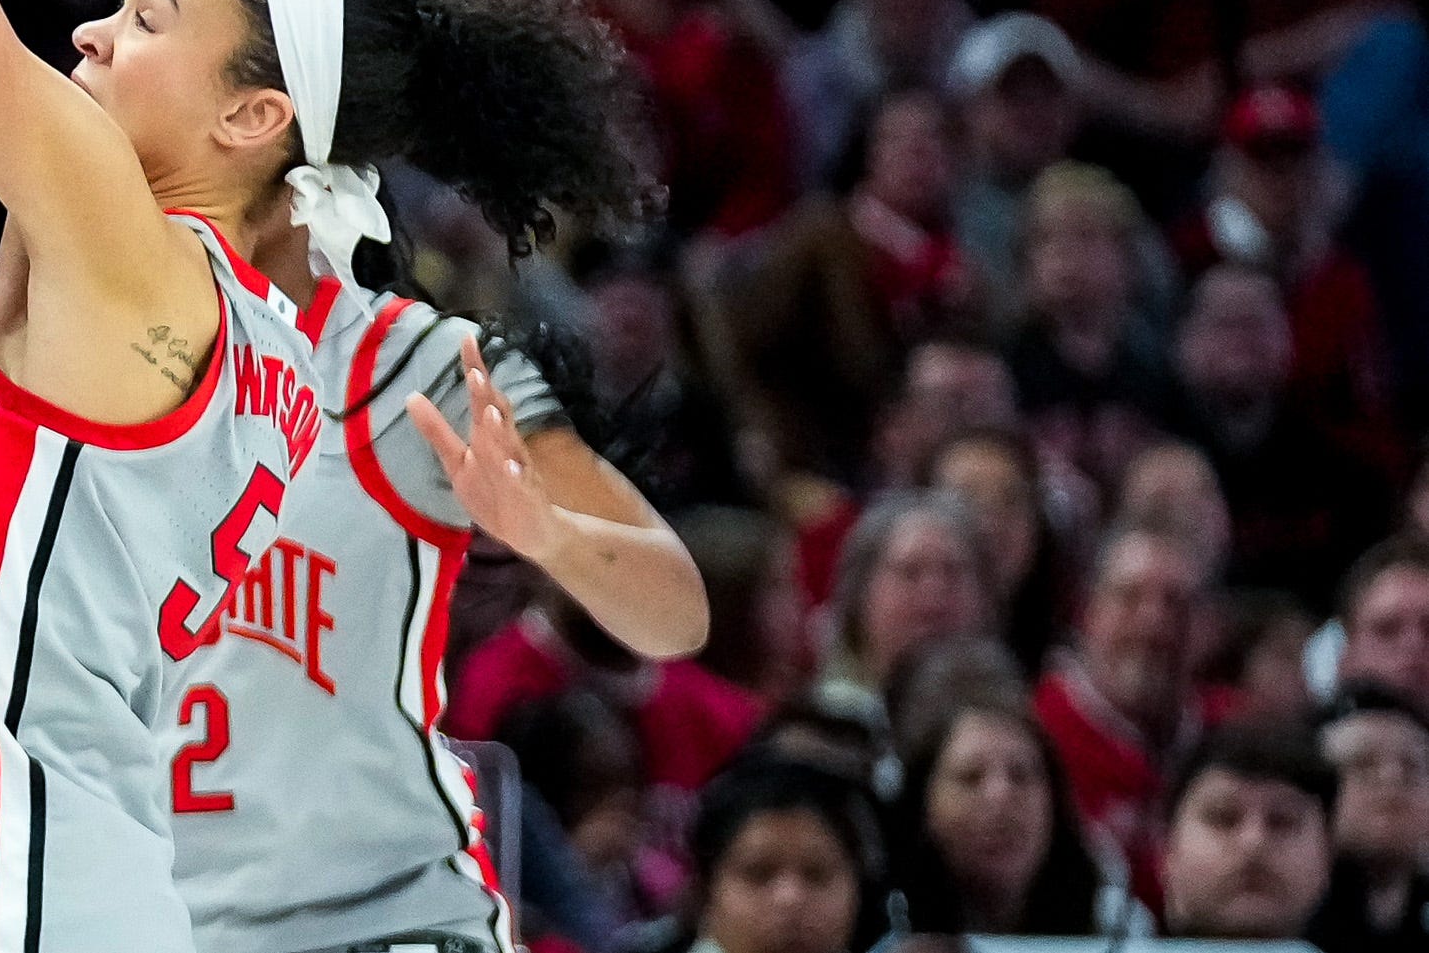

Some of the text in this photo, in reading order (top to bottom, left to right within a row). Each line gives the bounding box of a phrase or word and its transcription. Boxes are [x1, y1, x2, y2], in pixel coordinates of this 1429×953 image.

[233, 342, 322, 482] WTSON
[157, 460, 286, 663] 5
[207, 535, 338, 696] ATE
[171, 683, 235, 814] 2
